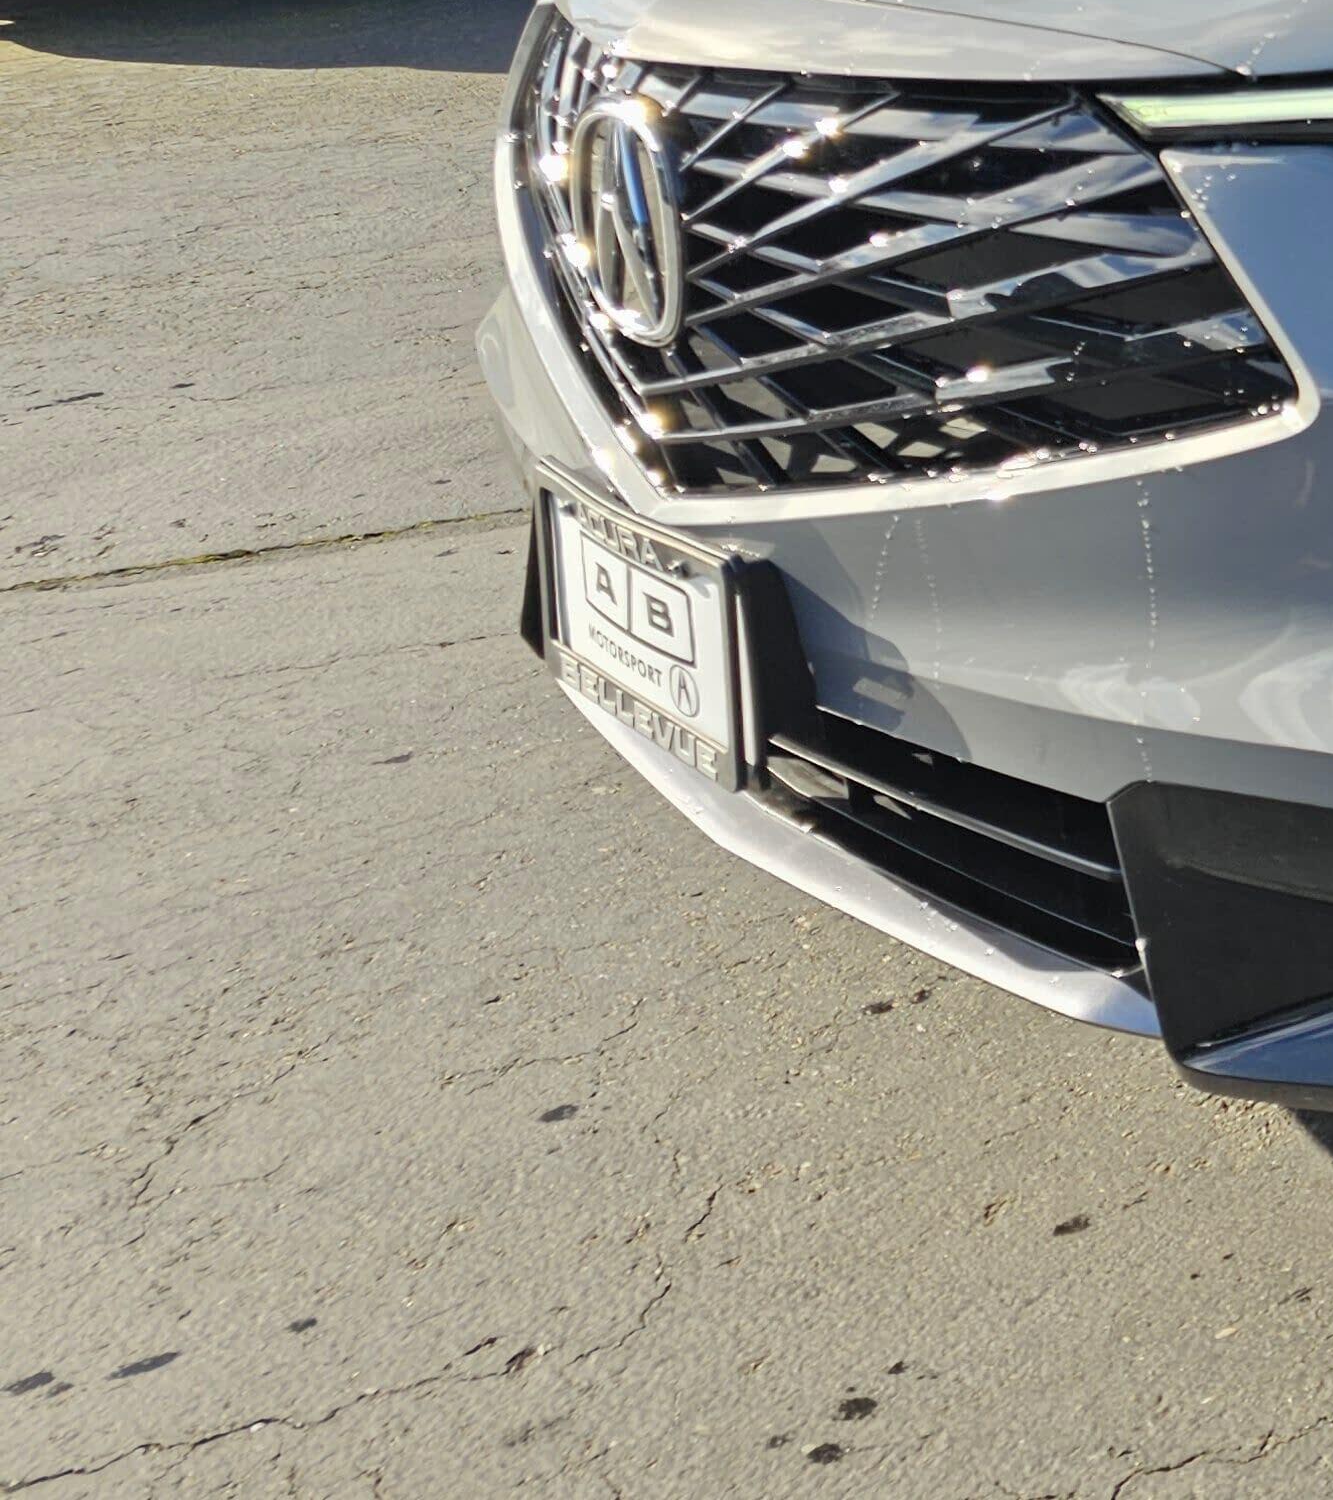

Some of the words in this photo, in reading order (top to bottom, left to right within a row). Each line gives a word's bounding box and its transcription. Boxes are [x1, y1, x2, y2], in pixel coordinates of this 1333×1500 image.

[577, 501, 665, 571] ACURA
[588, 623, 662, 689] MOTORSPORT
[560, 652, 718, 782] BELLEVUE
